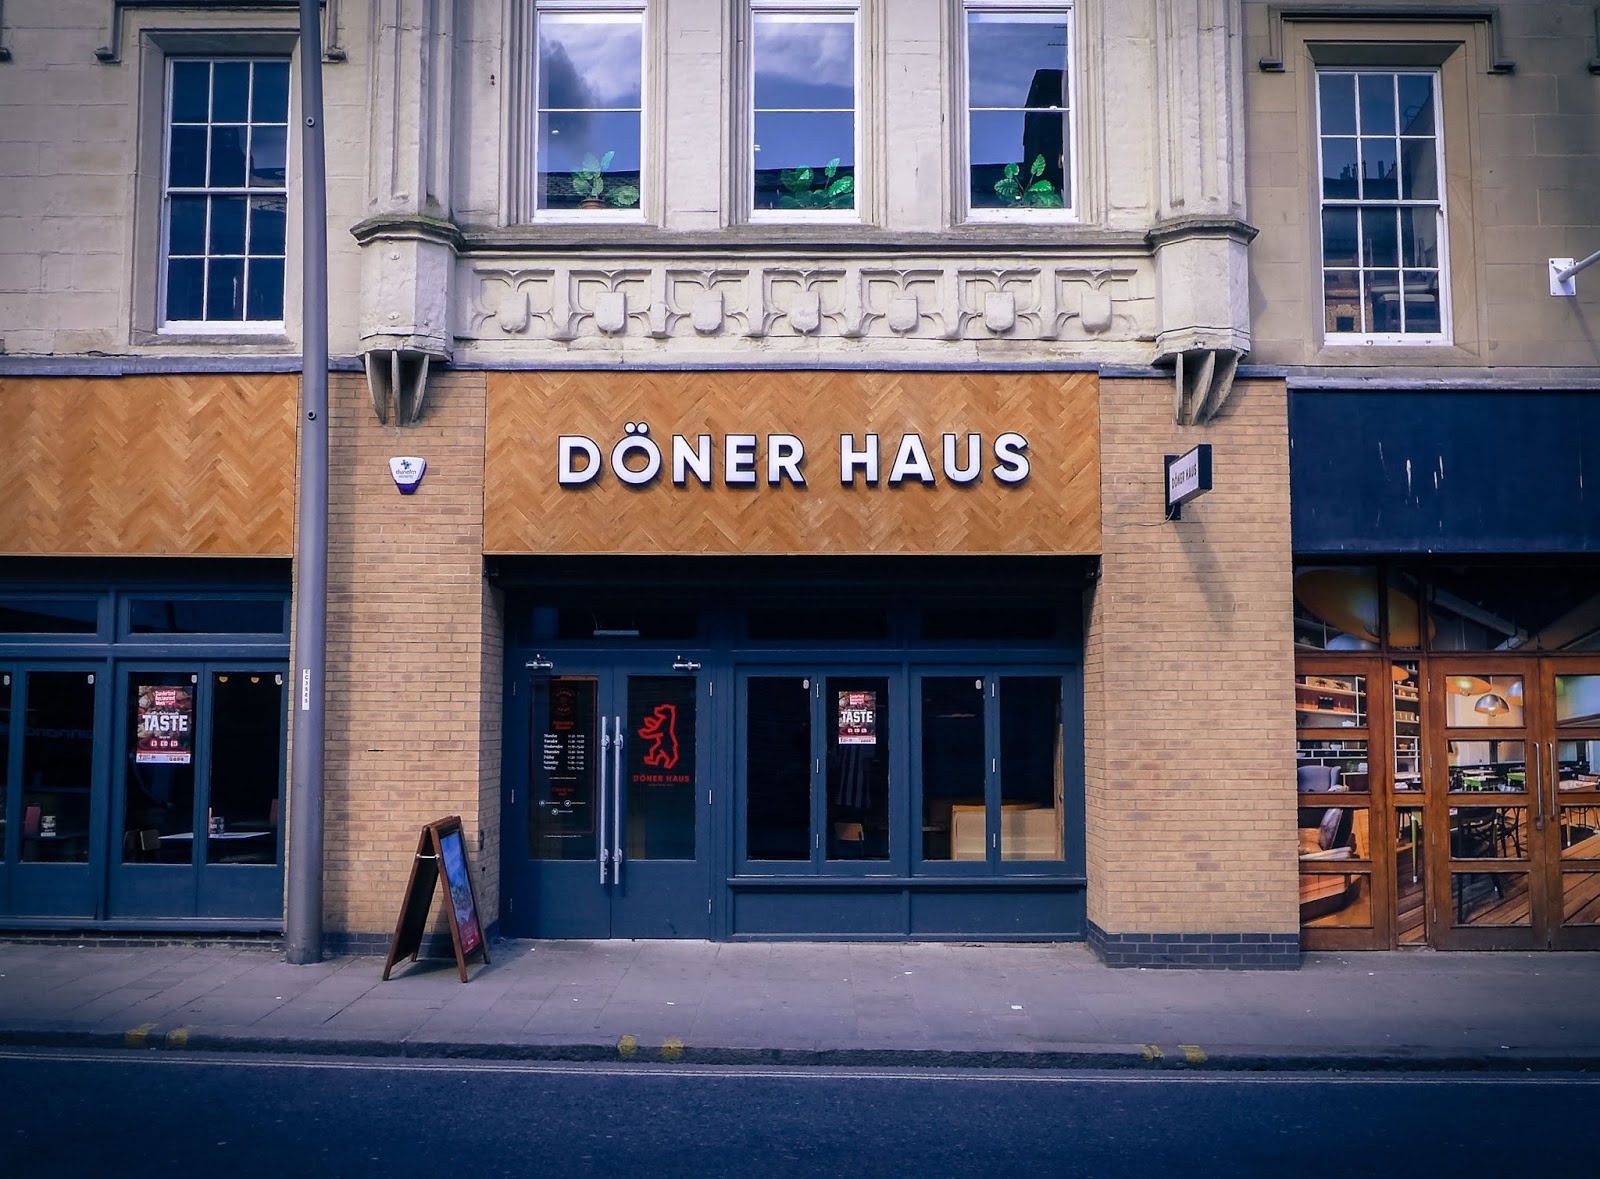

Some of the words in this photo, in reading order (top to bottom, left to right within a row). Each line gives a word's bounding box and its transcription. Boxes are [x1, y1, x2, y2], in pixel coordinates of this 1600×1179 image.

[557, 421, 806, 486] DÖNER
[840, 432, 1032, 487] HAUS
[1171, 470, 1185, 490] DÖNER
[1186, 463, 1197, 480] HAUS
[142, 714, 188, 732] TASTE
[841, 711, 873, 723] TASTE
[633, 773, 663, 783] DÖNER
[665, 775, 690, 783] HAUS
